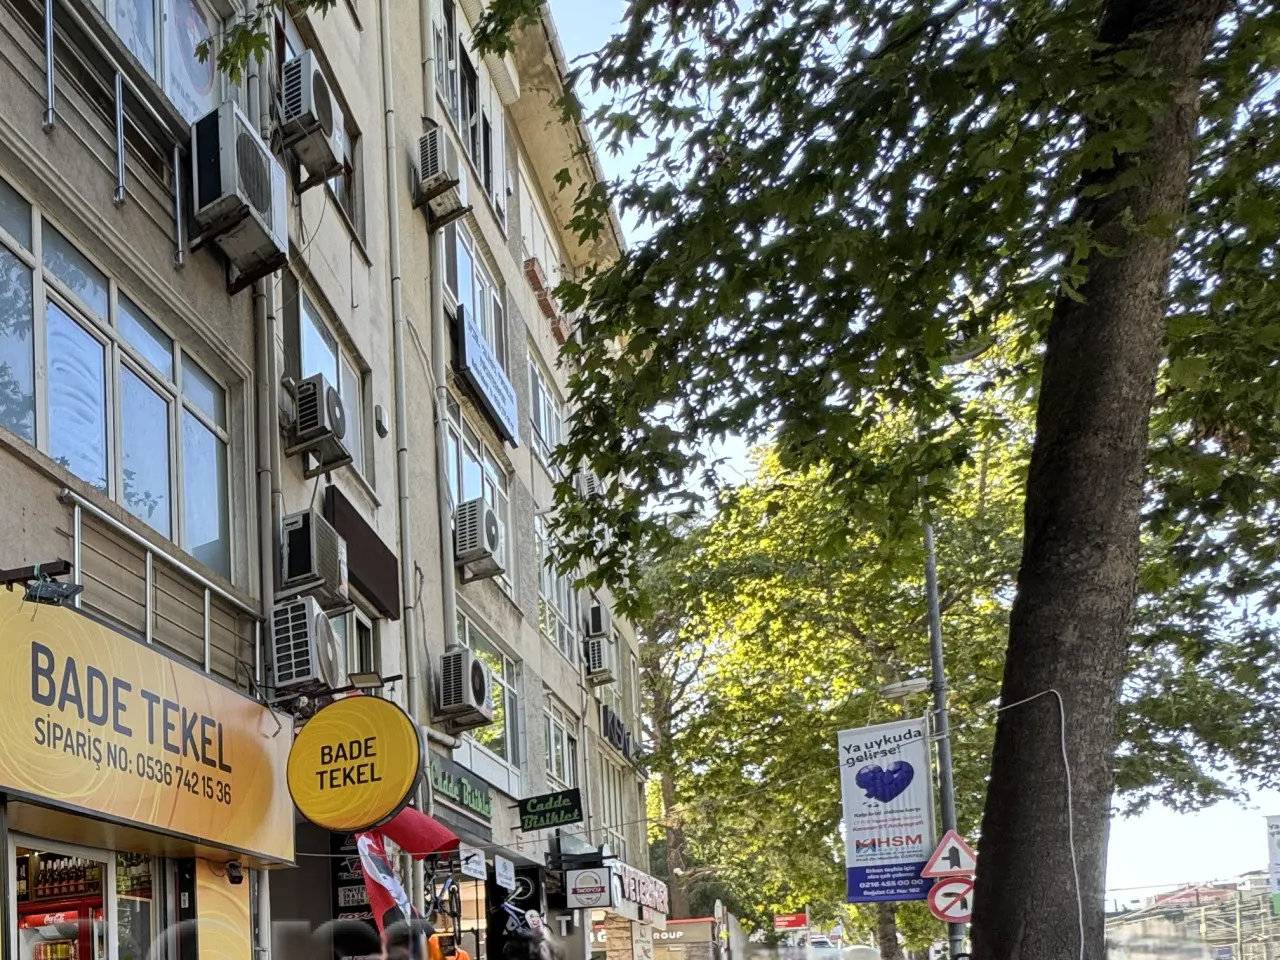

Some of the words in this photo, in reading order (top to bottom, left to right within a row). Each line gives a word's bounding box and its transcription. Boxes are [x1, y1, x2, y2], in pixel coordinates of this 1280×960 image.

[31, 640, 132, 738] BADE
[140, 690, 232, 774] TEKEL
[320, 736, 377, 766] BADE
[842, 743, 861, 755] Ya
[864, 728, 923, 749] uykuda
[34, 713, 102, 771] SİPARİŞ
[106, 743, 133, 774] NO:
[136, 752, 172, 786] 0536
[176, 764, 199, 794] 742
[201, 772, 214, 799] 15
[216, 777, 232, 805] 36
[316, 763, 382, 791] TEKEL
[526, 795, 572, 813] Cadde
[521, 808, 581, 830] Bisiklet
[877, 833, 923, 848] HSM
[653, 931, 685, 940] ROUP
